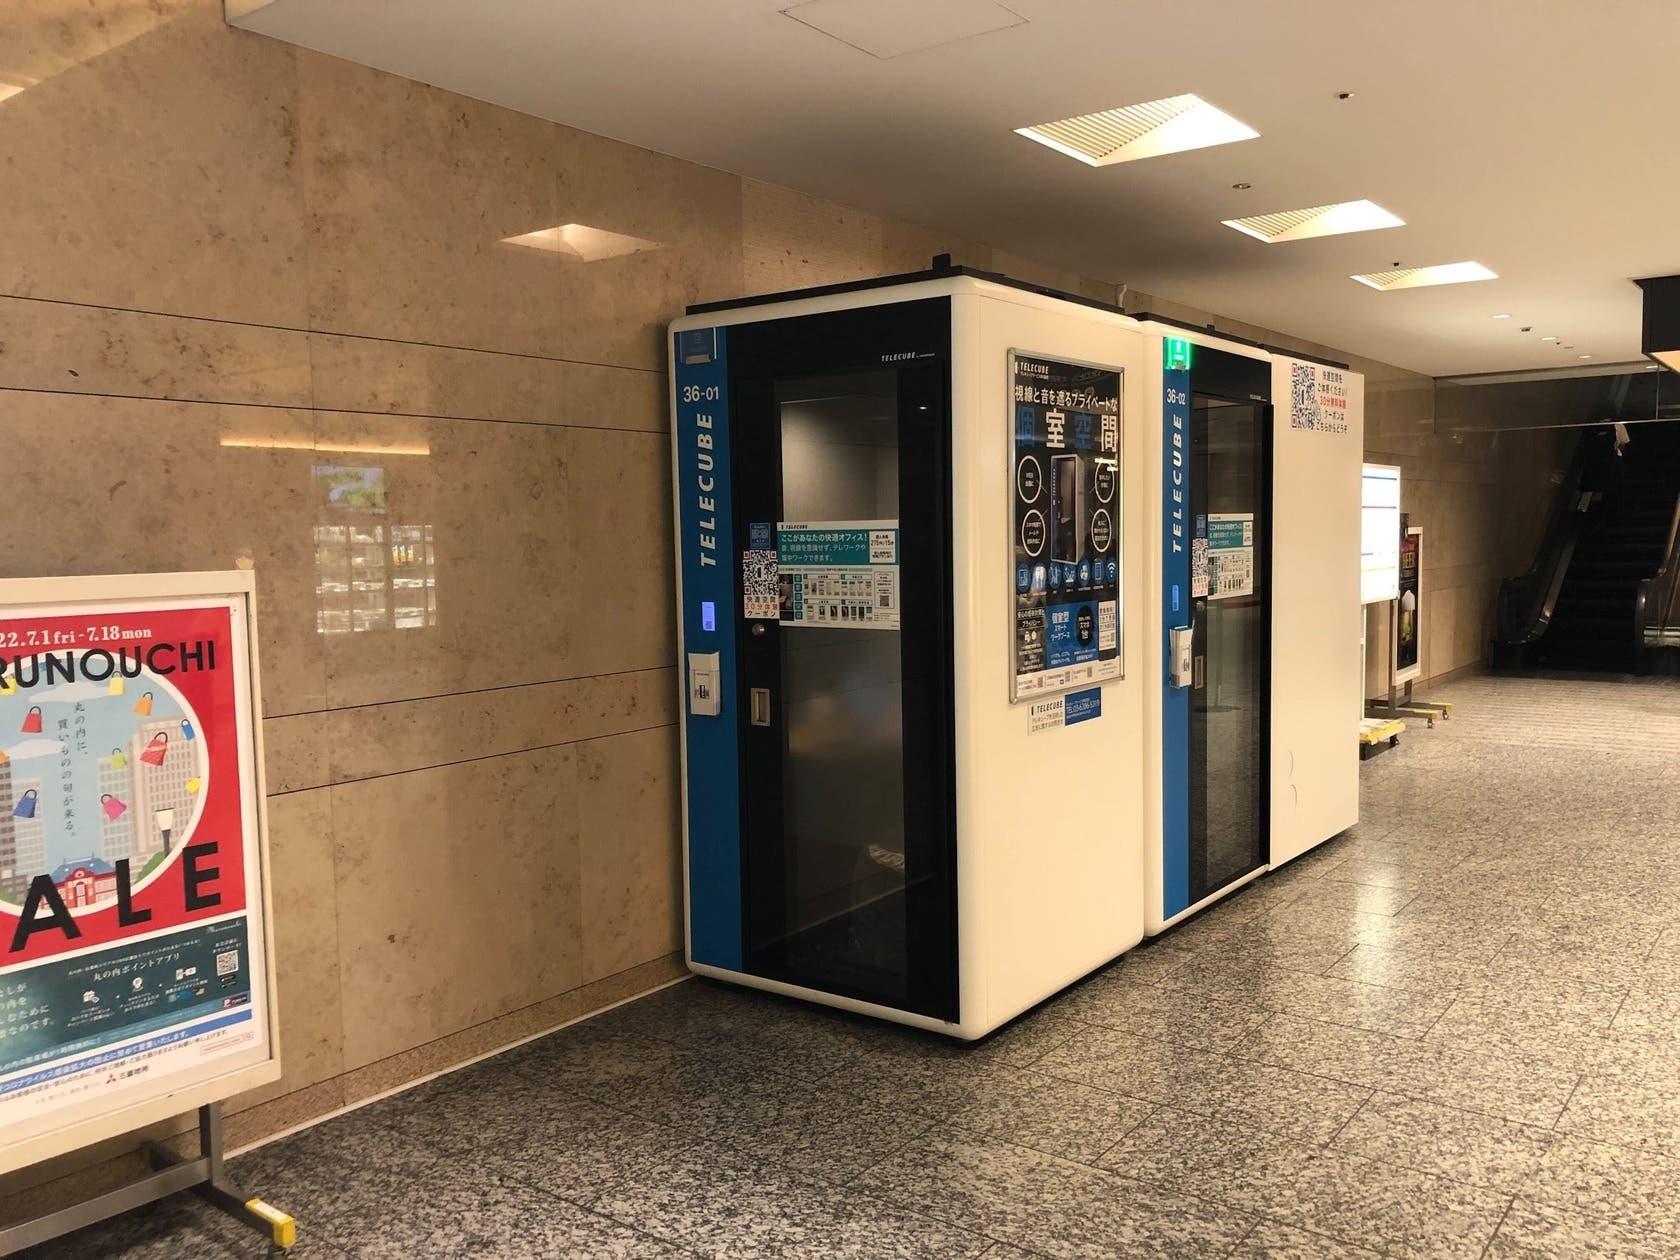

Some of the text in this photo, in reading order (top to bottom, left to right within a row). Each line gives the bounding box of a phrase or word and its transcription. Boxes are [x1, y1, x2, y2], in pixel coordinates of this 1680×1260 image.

[881, 351, 916, 362] TELECUBE
[1020, 361, 1049, 374] TELECUBE
[683, 385, 719, 402] 36-01
[1166, 388, 1186, 405] 36-02
[696, 413, 717, 568] TELECUBE
[1173, 414, 1182, 553] TELECUBE
[93, 952, 180, 982] 丸の内ポイントアプリ
